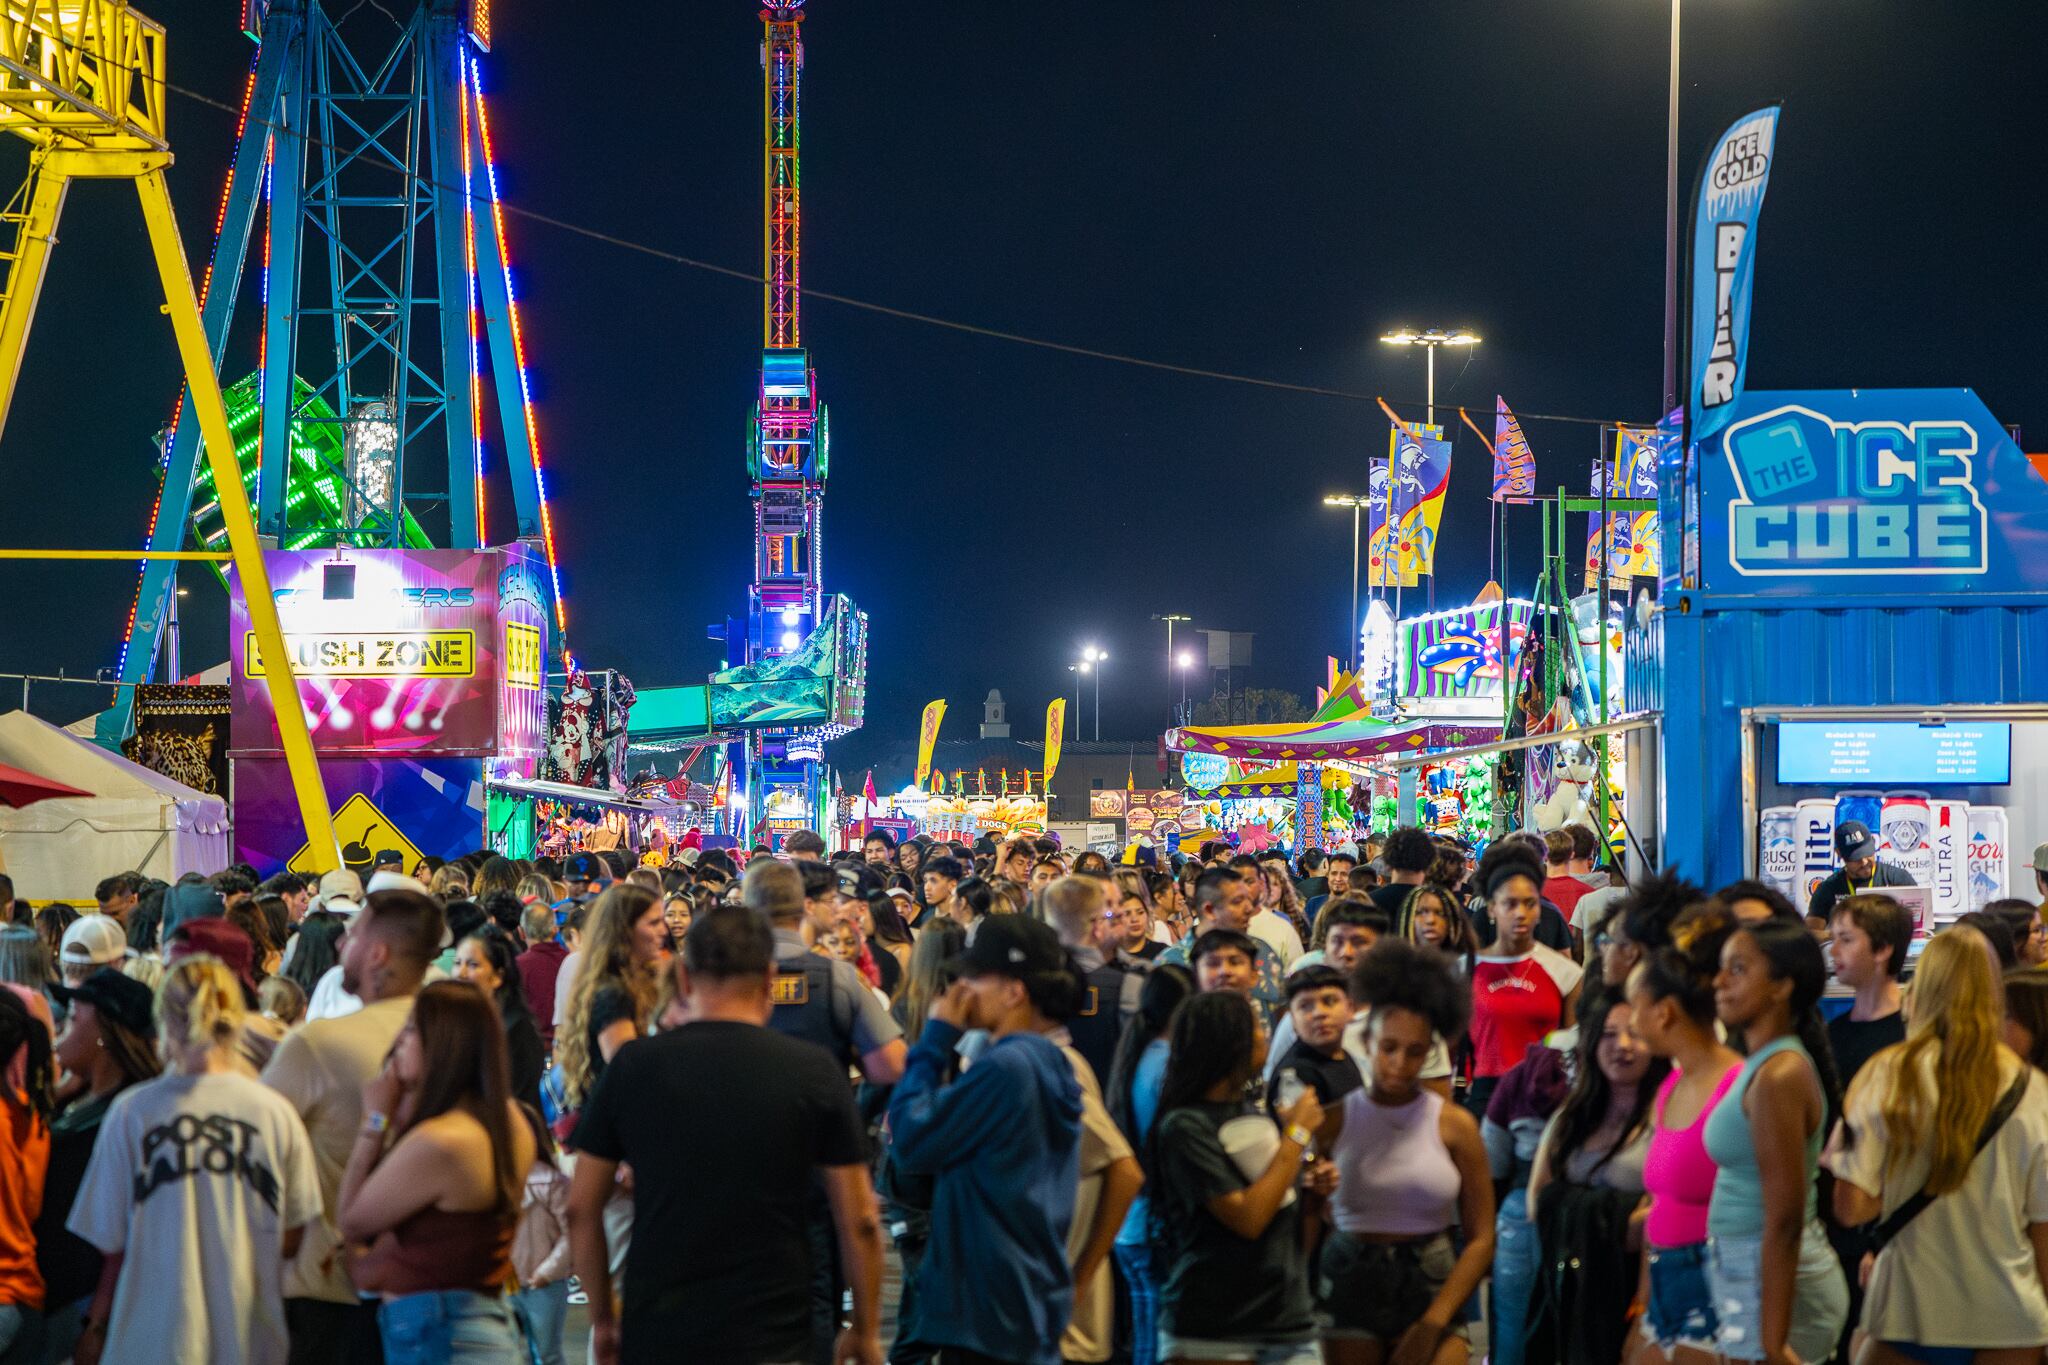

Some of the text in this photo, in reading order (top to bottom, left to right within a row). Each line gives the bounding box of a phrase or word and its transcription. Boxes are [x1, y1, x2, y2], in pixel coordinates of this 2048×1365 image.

[1727, 131, 1759, 162] ICE
[1714, 153, 1767, 190] COLD
[1753, 427, 1961, 497] THE ICE
[1736, 504, 1970, 559] CUBE
[257, 640, 463, 667] USH ZONE
[982, 820, 1007, 830] DOGS
[1764, 851, 1796, 864] BUSC
[1882, 857, 1930, 868] udweise
[1968, 842, 2004, 859] oor
[1938, 834, 1953, 898] ULTRA
[1970, 861, 2002, 873] GHT
[144, 1114, 259, 1165] POST
